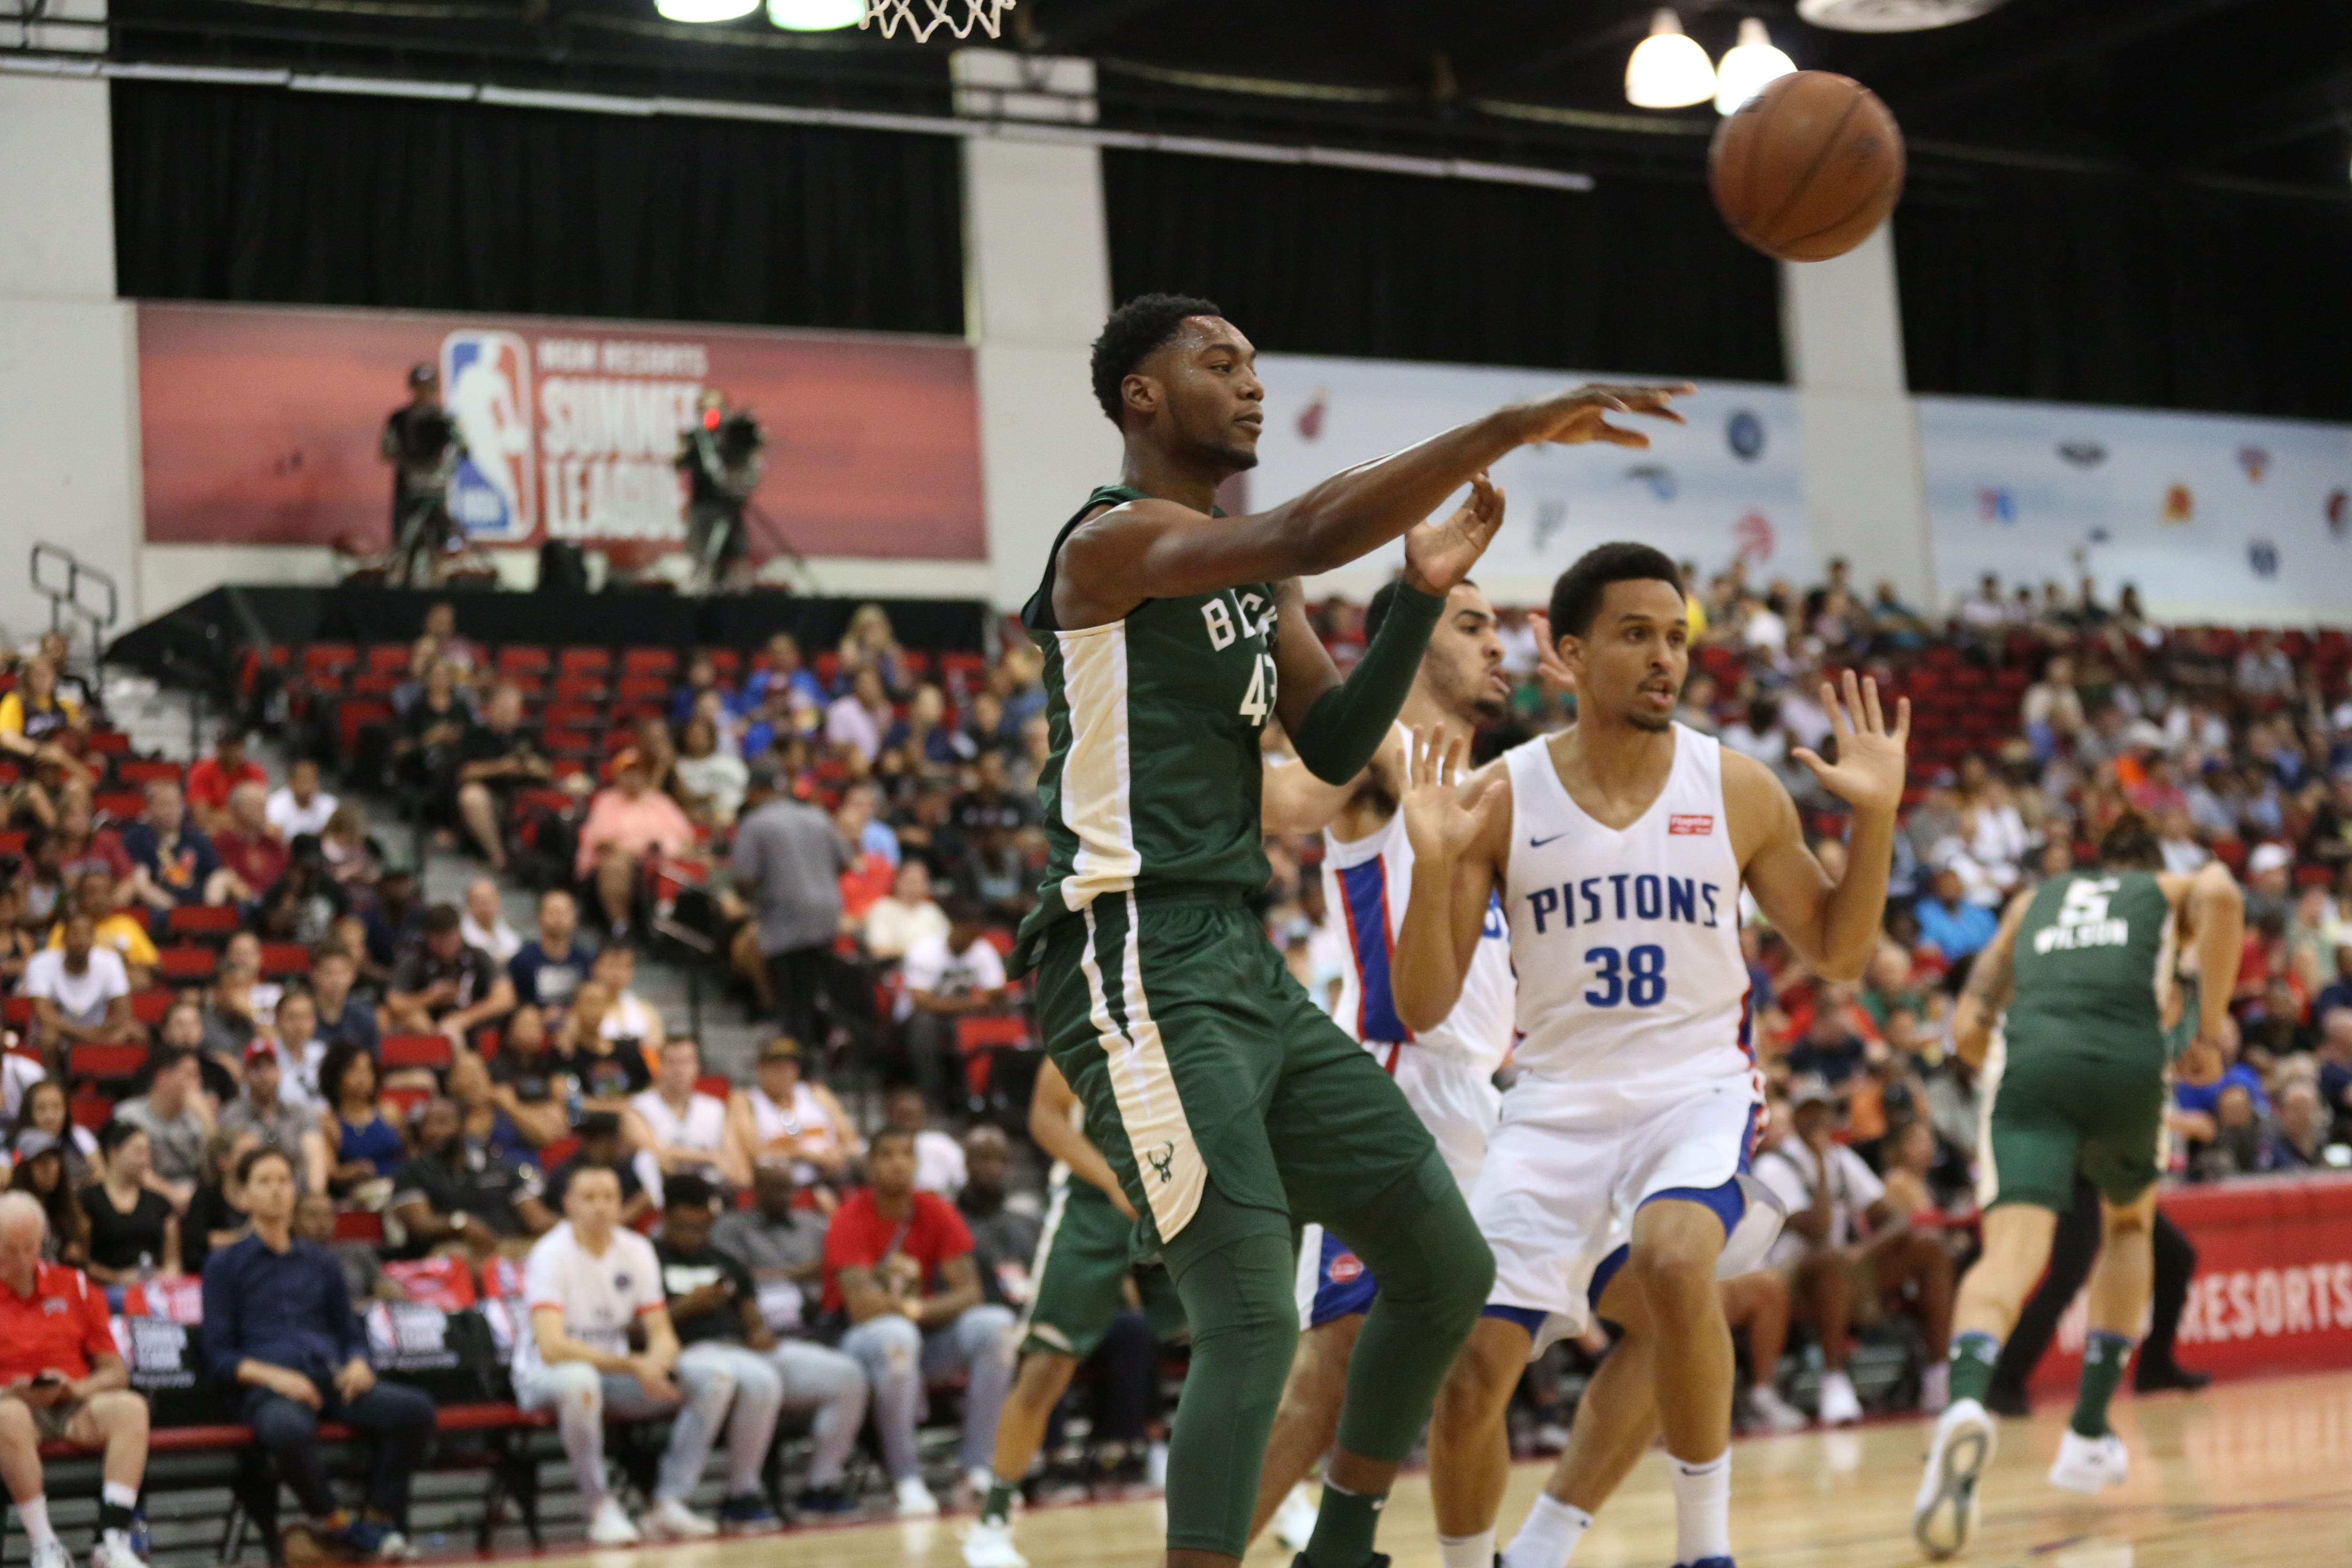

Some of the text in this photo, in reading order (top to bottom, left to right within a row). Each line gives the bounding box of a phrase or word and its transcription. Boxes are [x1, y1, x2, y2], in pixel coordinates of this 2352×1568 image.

[1526, 874, 1720, 934] PISTONS
[2058, 877, 2121, 928] 5
[2034, 919, 2129, 955] WILSON
[1584, 944, 1667, 1008] 38
